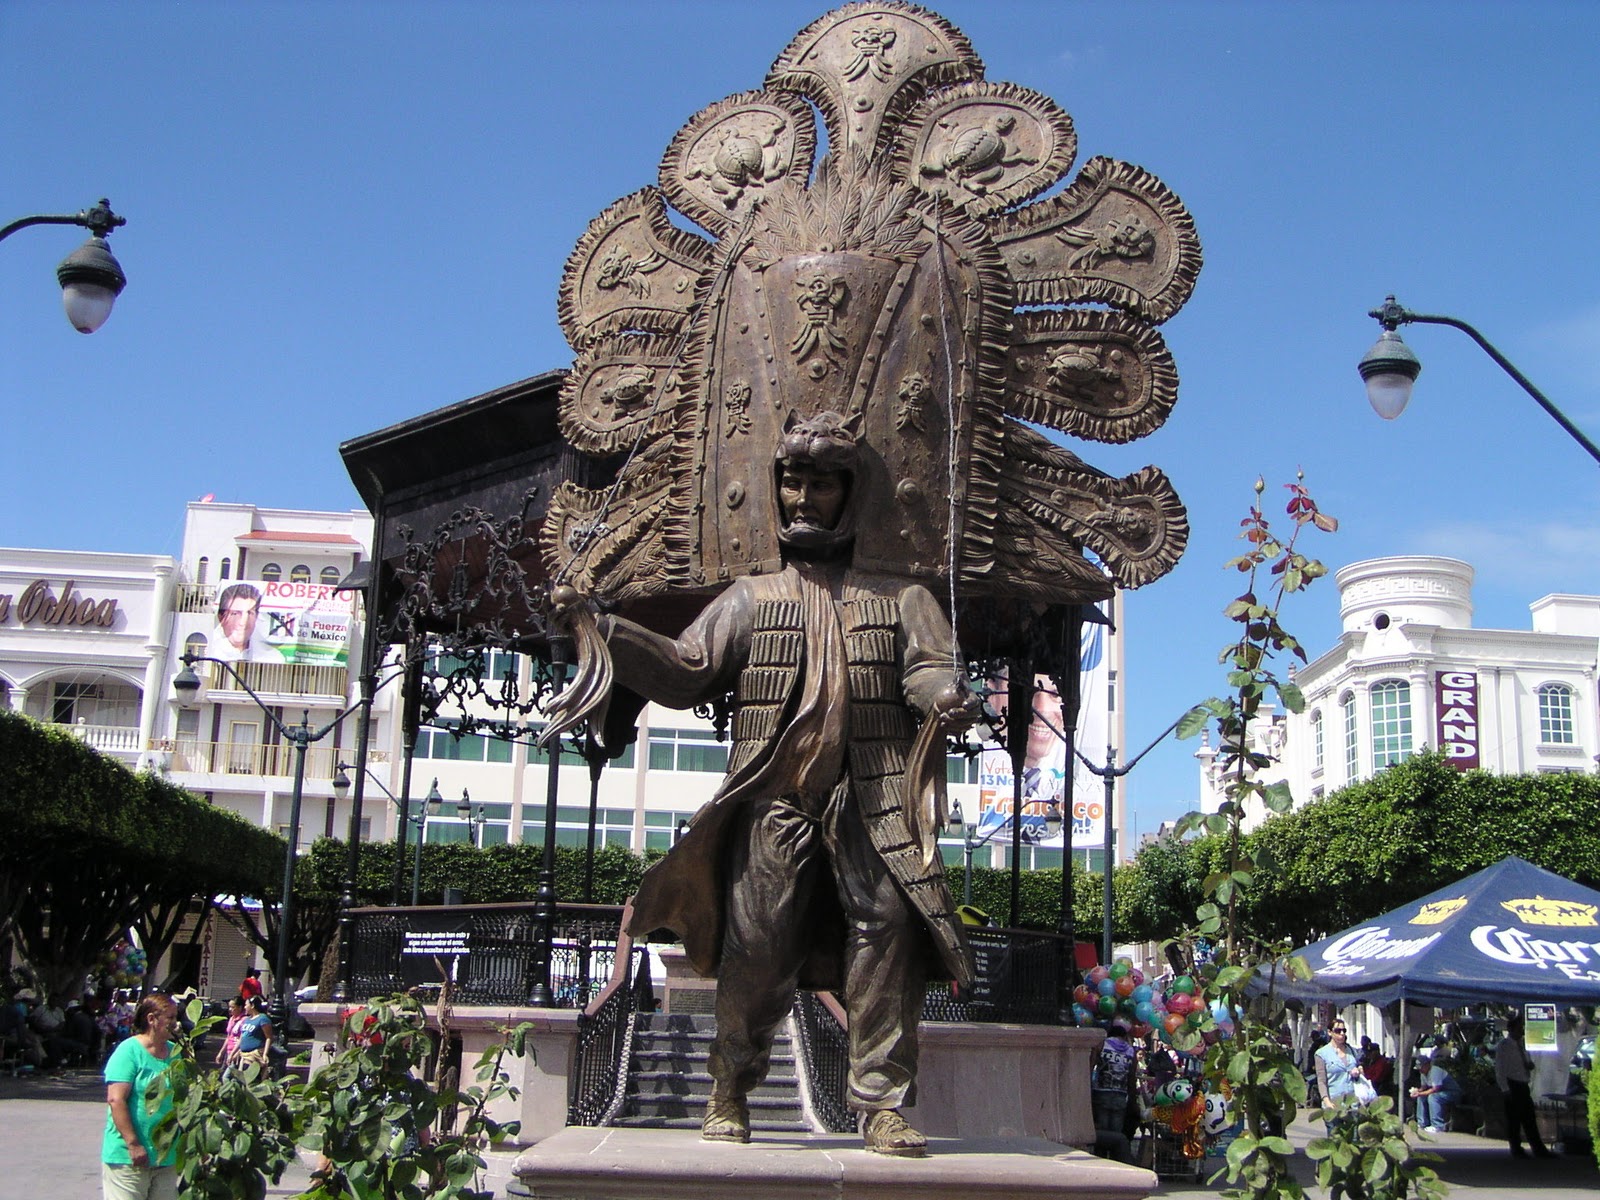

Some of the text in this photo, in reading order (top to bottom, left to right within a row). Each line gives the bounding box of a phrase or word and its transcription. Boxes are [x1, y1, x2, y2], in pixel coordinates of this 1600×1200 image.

[17, 579, 118, 627] Ochoa
[313, 621, 347, 632] Fuerza
[311, 631, 346, 642] México
[1440, 672, 1476, 758] GRAND
[980, 775, 994, 786] 13
